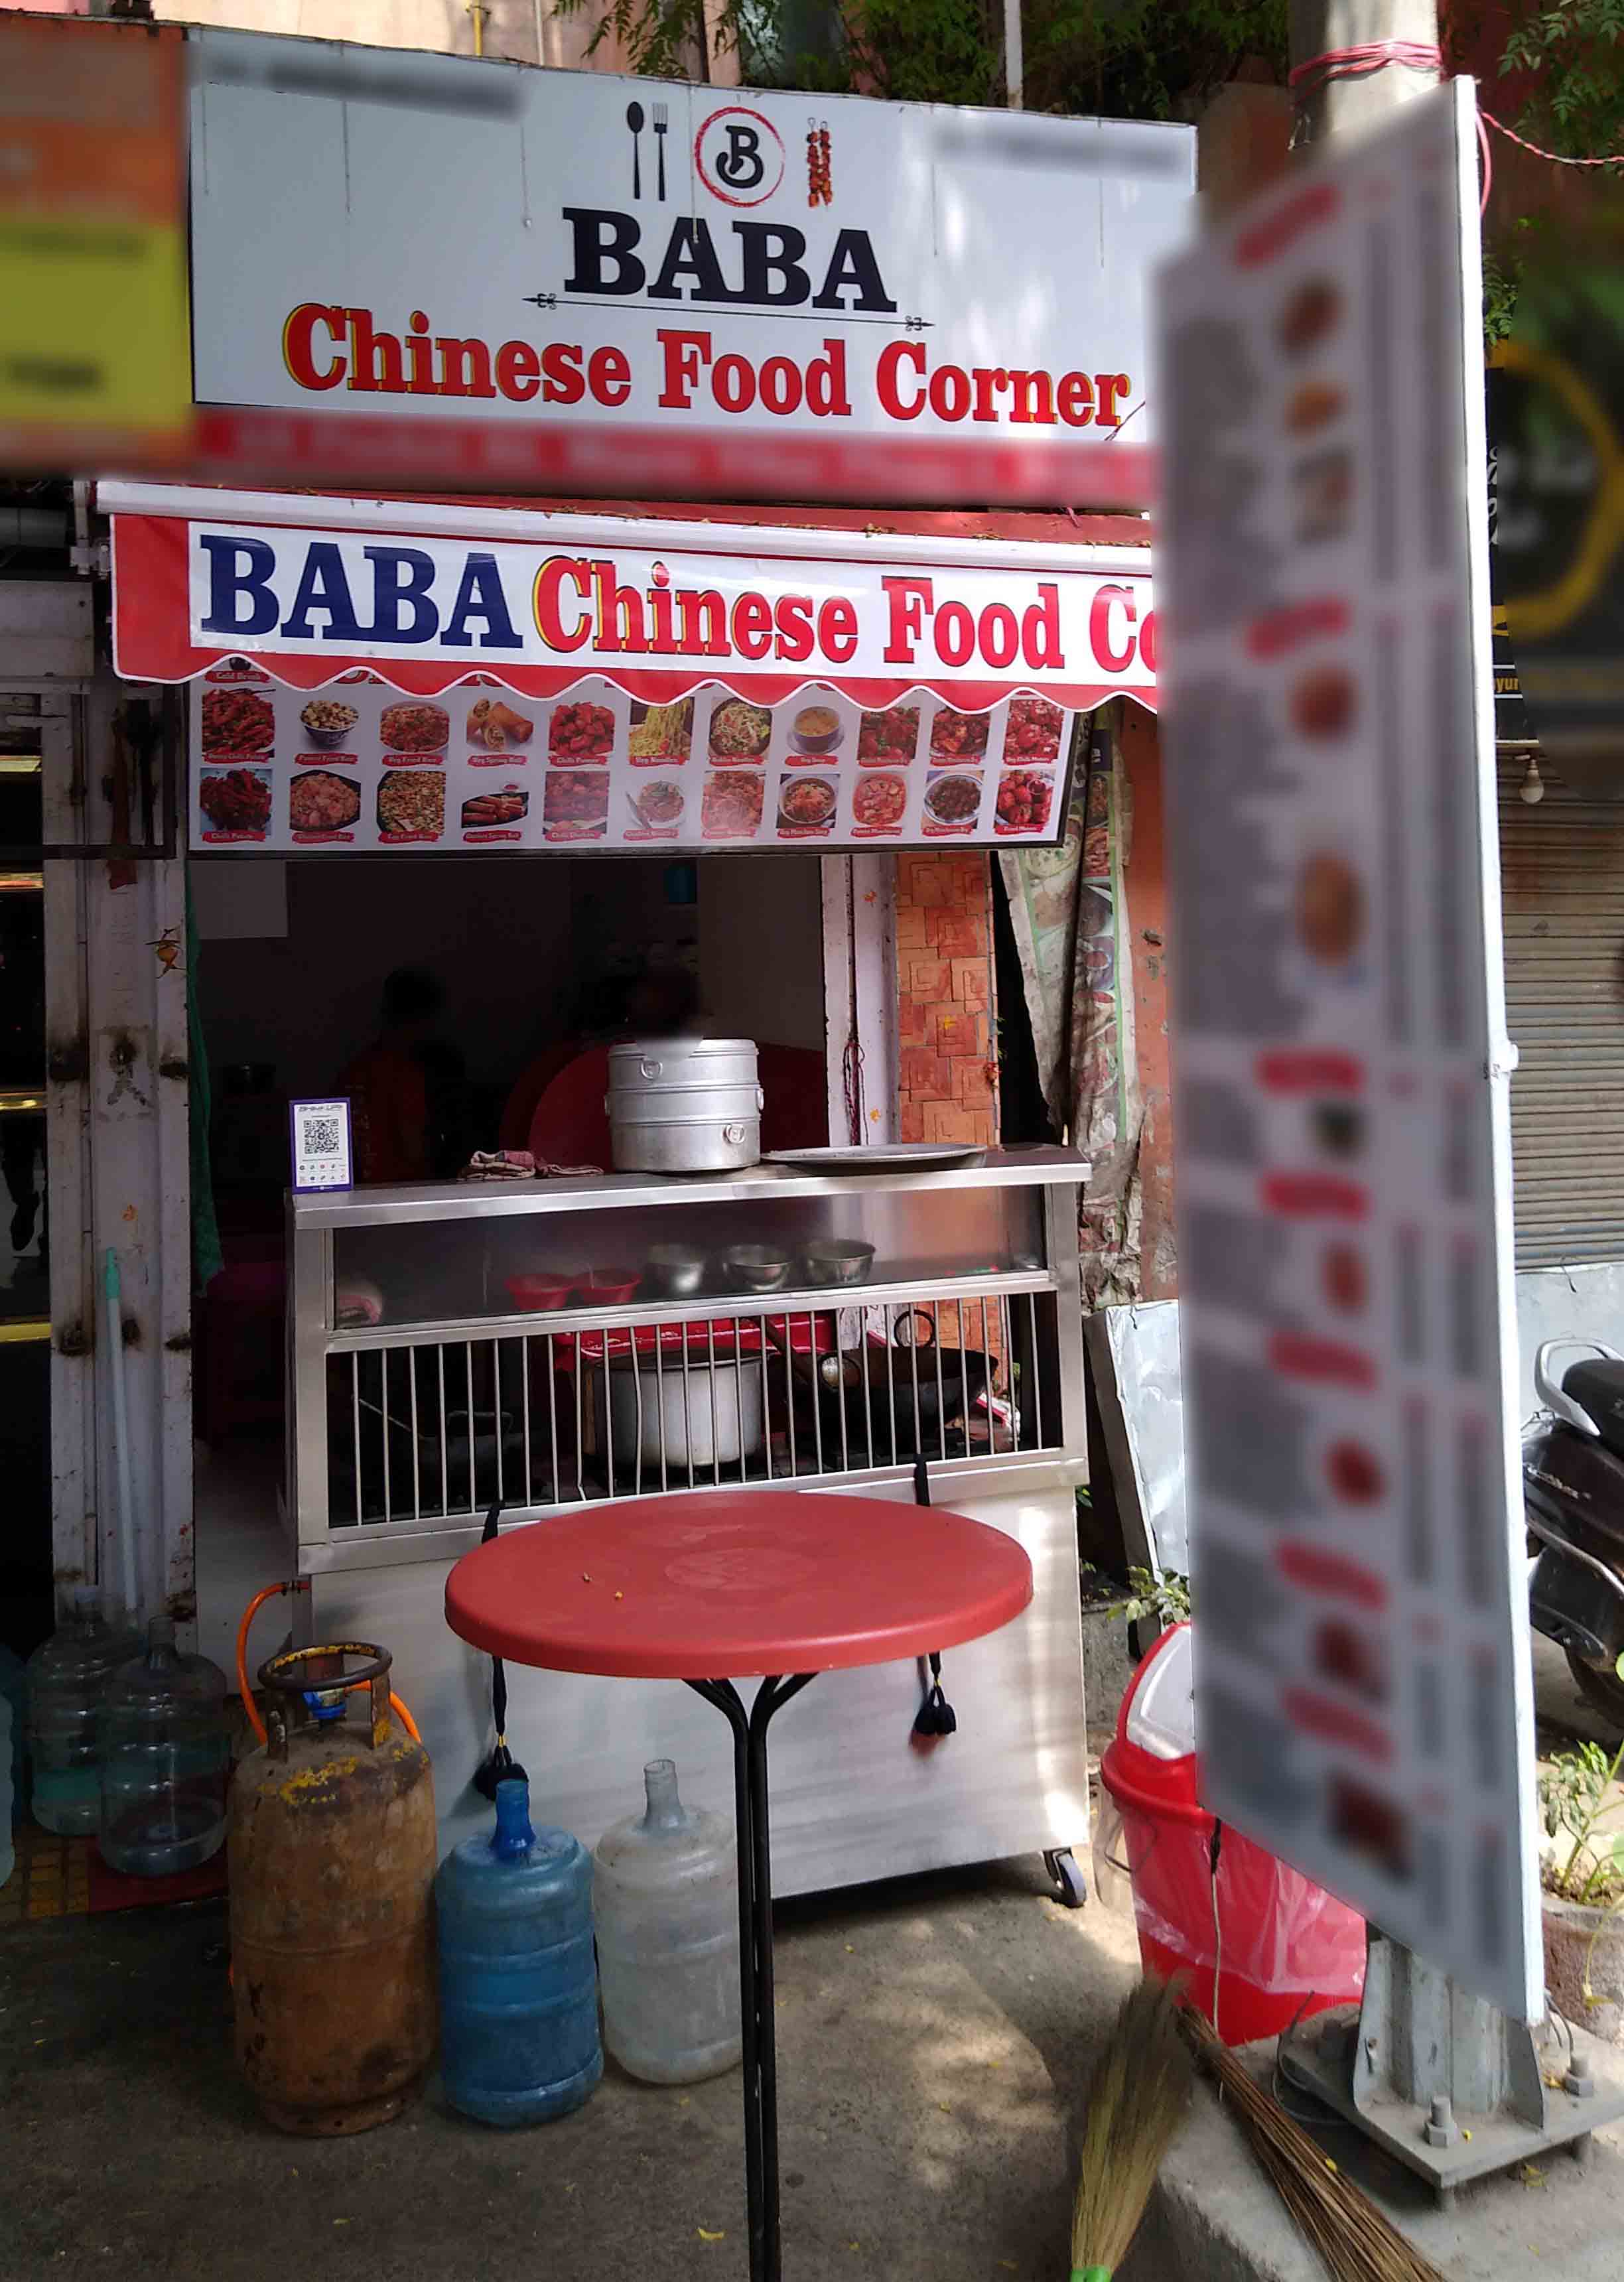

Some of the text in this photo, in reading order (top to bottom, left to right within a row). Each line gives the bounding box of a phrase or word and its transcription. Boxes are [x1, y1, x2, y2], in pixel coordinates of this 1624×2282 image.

[563, 207, 897, 312] BABA
[283, 302, 1130, 427] Chinese Food Corner
[200, 534, 523, 649] BABA
[532, 554, 858, 663] Chinese
[882, 575, 1065, 669] Food
